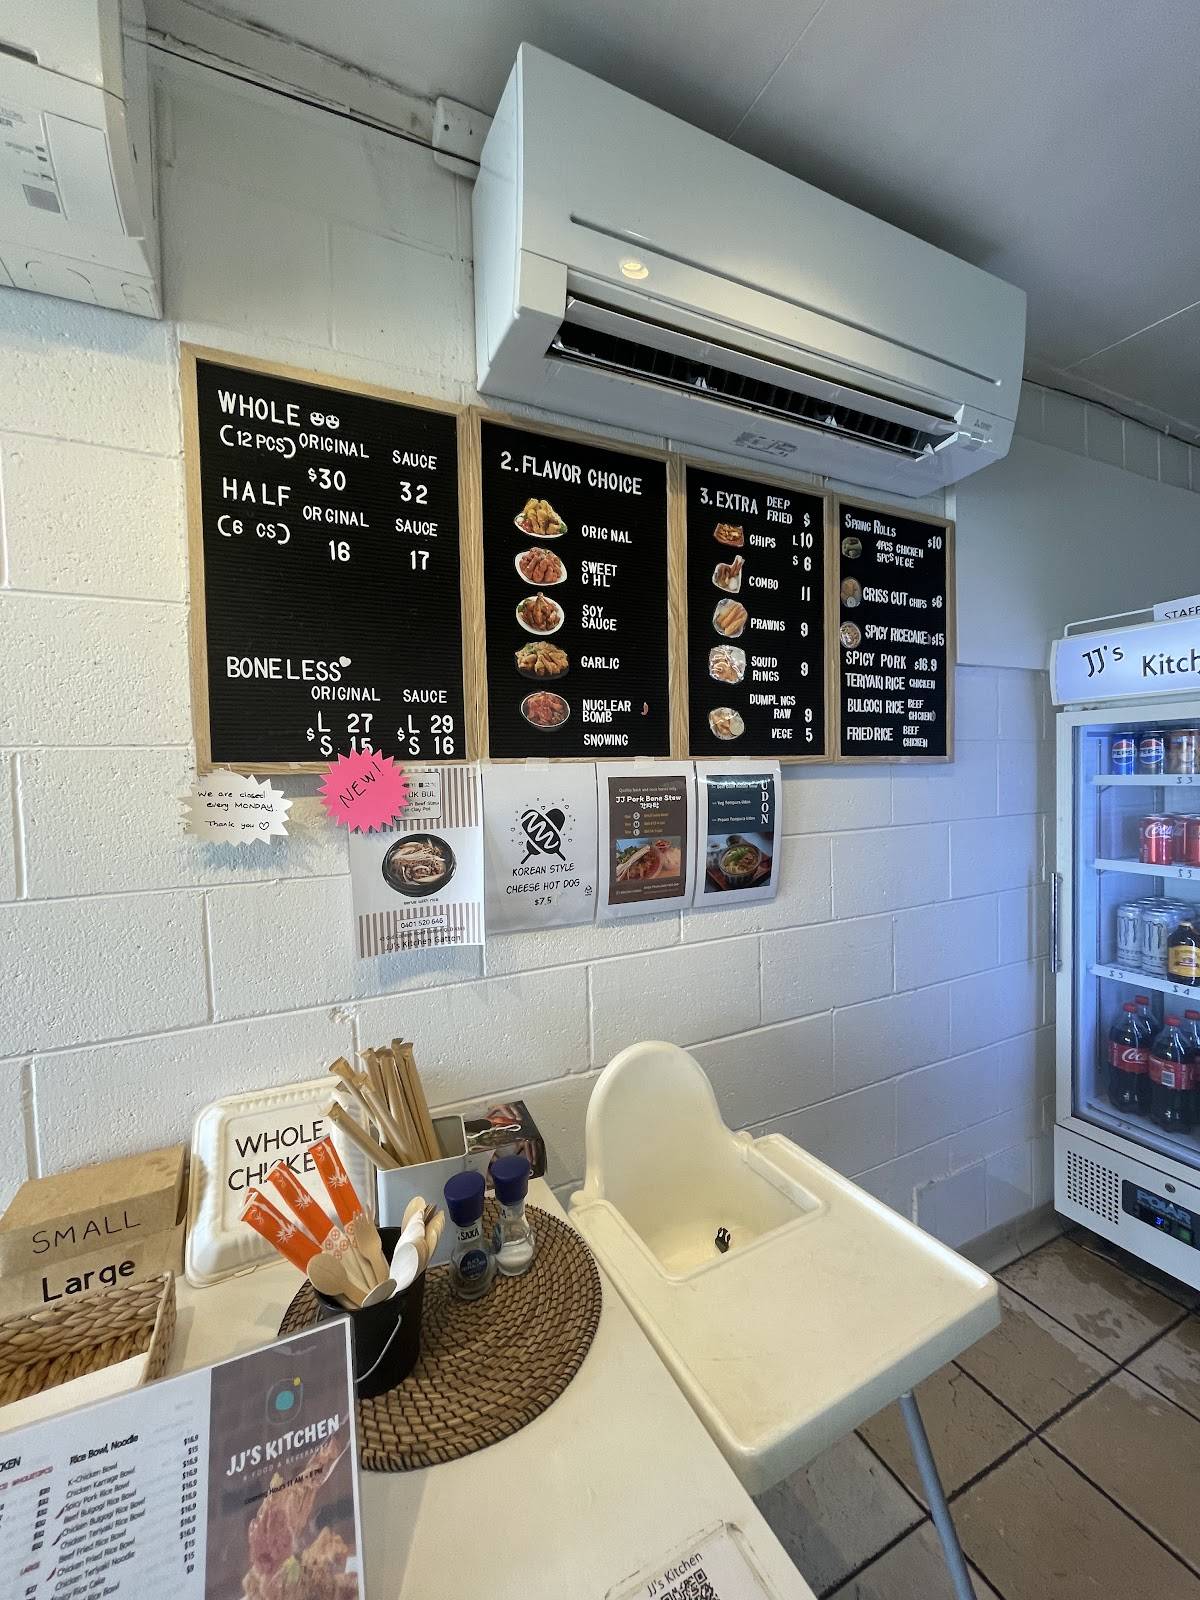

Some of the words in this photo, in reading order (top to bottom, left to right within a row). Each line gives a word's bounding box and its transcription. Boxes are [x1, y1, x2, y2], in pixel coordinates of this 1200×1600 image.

[218, 390, 300, 429] WHOLE
[299, 433, 369, 458] ORIGINAL
[393, 450, 437, 470] SAUCE
[308, 468, 346, 490] $30
[400, 481, 427, 504] 32
[588, 469, 642, 495] CHOICE
[223, 477, 291, 506] HALF
[767, 496, 790, 509] DEEP
[767, 510, 792, 524] FRIED
[395, 518, 438, 536] SAUCE
[750, 534, 776, 548] CHIPS
[876, 540, 893, 552] 4PCS
[896, 544, 923, 558] CHICKEN
[928, 536, 941, 549] $10
[329, 540, 350, 561] 16
[410, 551, 429, 570] 17
[804, 556, 811, 571] 6
[582, 561, 617, 579] SWEET
[749, 576, 778, 590] COMBO
[863, 587, 888, 603] CRISS
[891, 591, 908, 606] CUT
[909, 598, 927, 608] CHIPS
[932, 596, 942, 608] $6
[582, 604, 603, 620] SOY
[582, 614, 617, 631] SAUCE
[751, 618, 785, 631] PRAWNS
[801, 622, 808, 637] 9
[865, 625, 888, 640] SPICY
[932, 633, 944, 646] $15
[227, 656, 341, 681] BONELESS
[581, 656, 619, 669] GARLIC
[751, 656, 777, 667] SQUID
[801, 662, 808, 676] 9
[846, 650, 874, 666] SPICY
[881, 654, 906, 669] PORK
[914, 658, 937, 671] $16.9
[1082, 646, 1123, 678] JJ's
[753, 670, 779, 682] RINGS
[845, 673, 883, 690] TERIYAKI
[885, 676, 905, 690] RICE
[909, 679, 935, 689] CHICKEN
[311, 686, 380, 701] ORIGINAL
[403, 689, 447, 703] SAUCE
[583, 699, 631, 714] NUCLEAR
[774, 709, 791, 719] RAW
[805, 708, 812, 722] 9
[886, 700, 904, 714] RICE
[908, 699, 924, 708] BEEF
[318, 711, 331, 732] L
[348, 713, 373, 733] 27
[408, 715, 420, 734] L
[431, 715, 453, 734] 29
[582, 711, 612, 723] BOMB
[584, 734, 628, 747] SNOWING
[806, 728, 813, 742] 5
[847, 727, 873, 740] FRIED
[874, 727, 893, 741] RICE
[903, 726, 919, 735] BEEF
[434, 736, 454, 755] 16
[903, 738, 927, 747] CHICKEN
[340, 761, 384, 808] NEW!
[207, 802, 229, 811] every
[761, 780, 769, 824] UDON
[512, 866, 546, 876] KOREAN
[550, 863, 575, 873] STYLE
[506, 884, 540, 894] CHEESE
[544, 881, 560, 890] HOT
[564, 879, 580, 888] DOG
[235, 1119, 324, 1158] WHOLE
[32, 1211, 141, 1253] SMALL
[41, 1259, 135, 1302] Large
[226, 1445, 261, 1476] JJ'S
[265, 1414, 340, 1461] KITCHEN
[647, 1579, 664, 1597] JJ's
[664, 1552, 704, 1584] Kitchen
